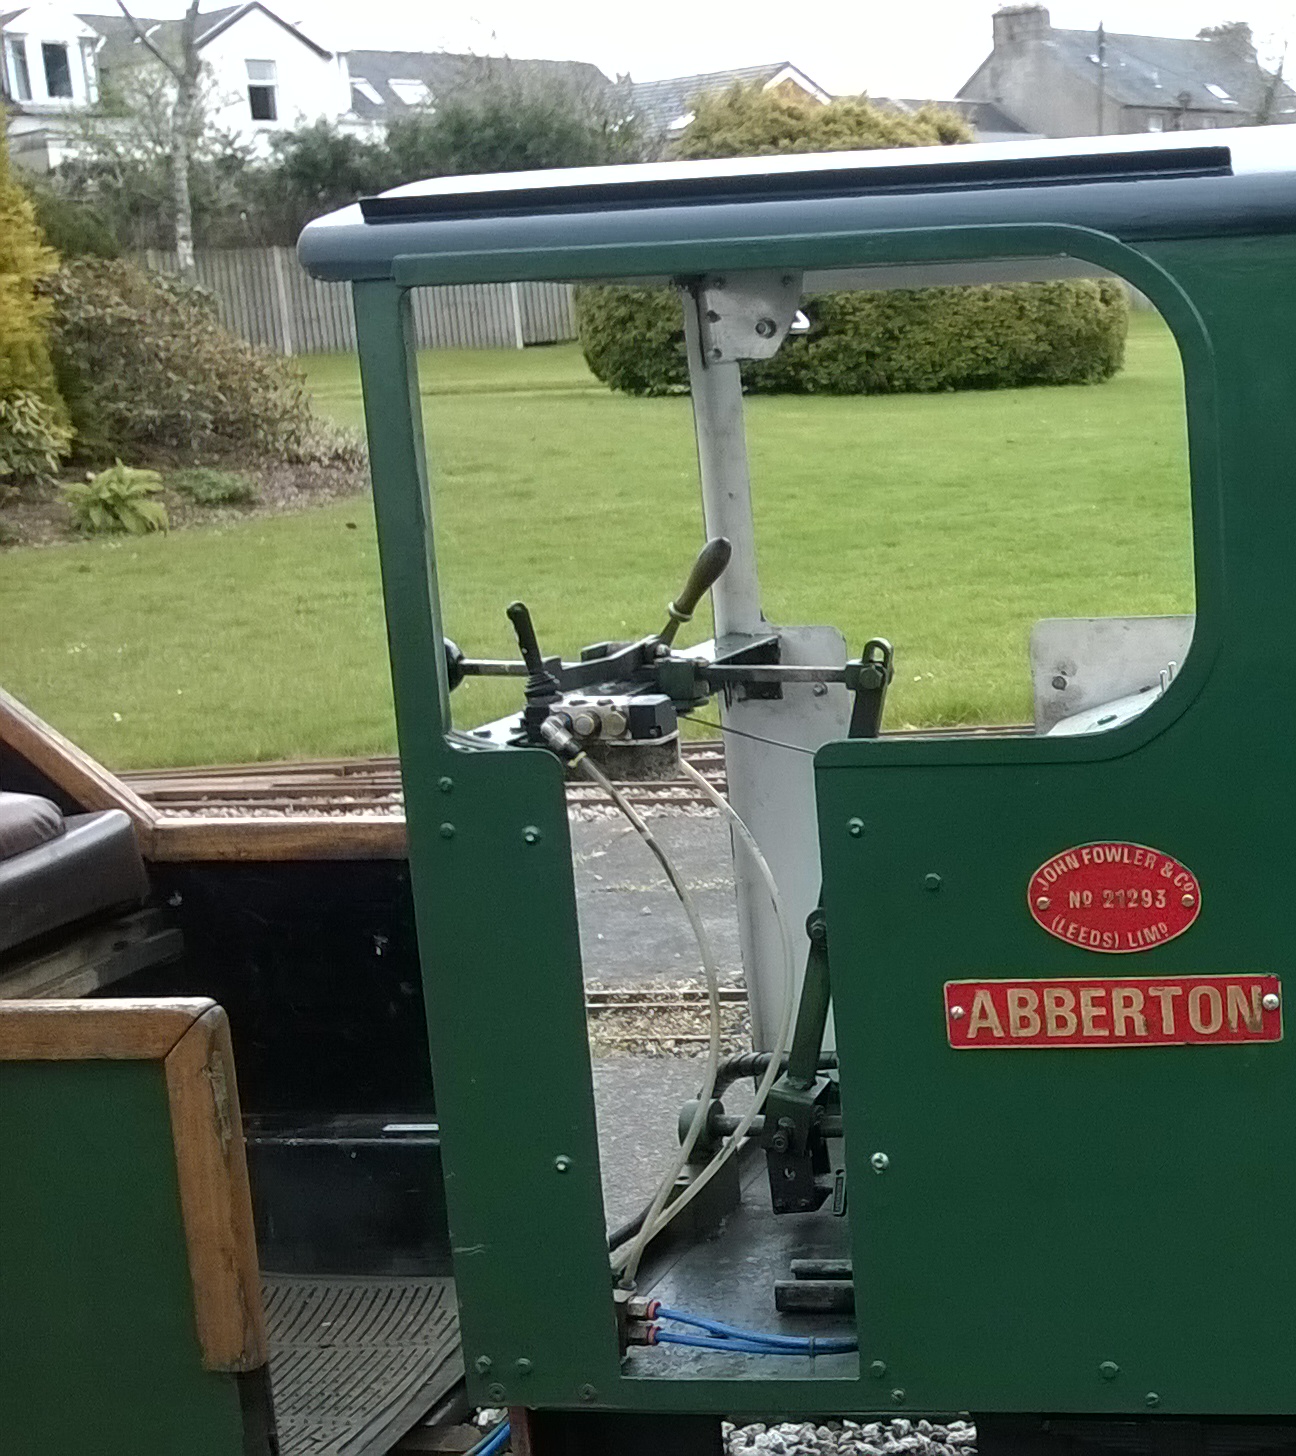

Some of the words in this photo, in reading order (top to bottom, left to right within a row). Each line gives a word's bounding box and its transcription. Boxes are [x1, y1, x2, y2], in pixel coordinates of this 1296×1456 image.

[1036, 856, 1079, 891] JOHN
[1081, 846, 1156, 870] FOWLER
[1160, 861, 1173, 878] &
[1103, 889, 1167, 909] 21293
[1051, 914, 1120, 949] (LEEDS)
[966, 985, 1264, 1038] ABBERTON
